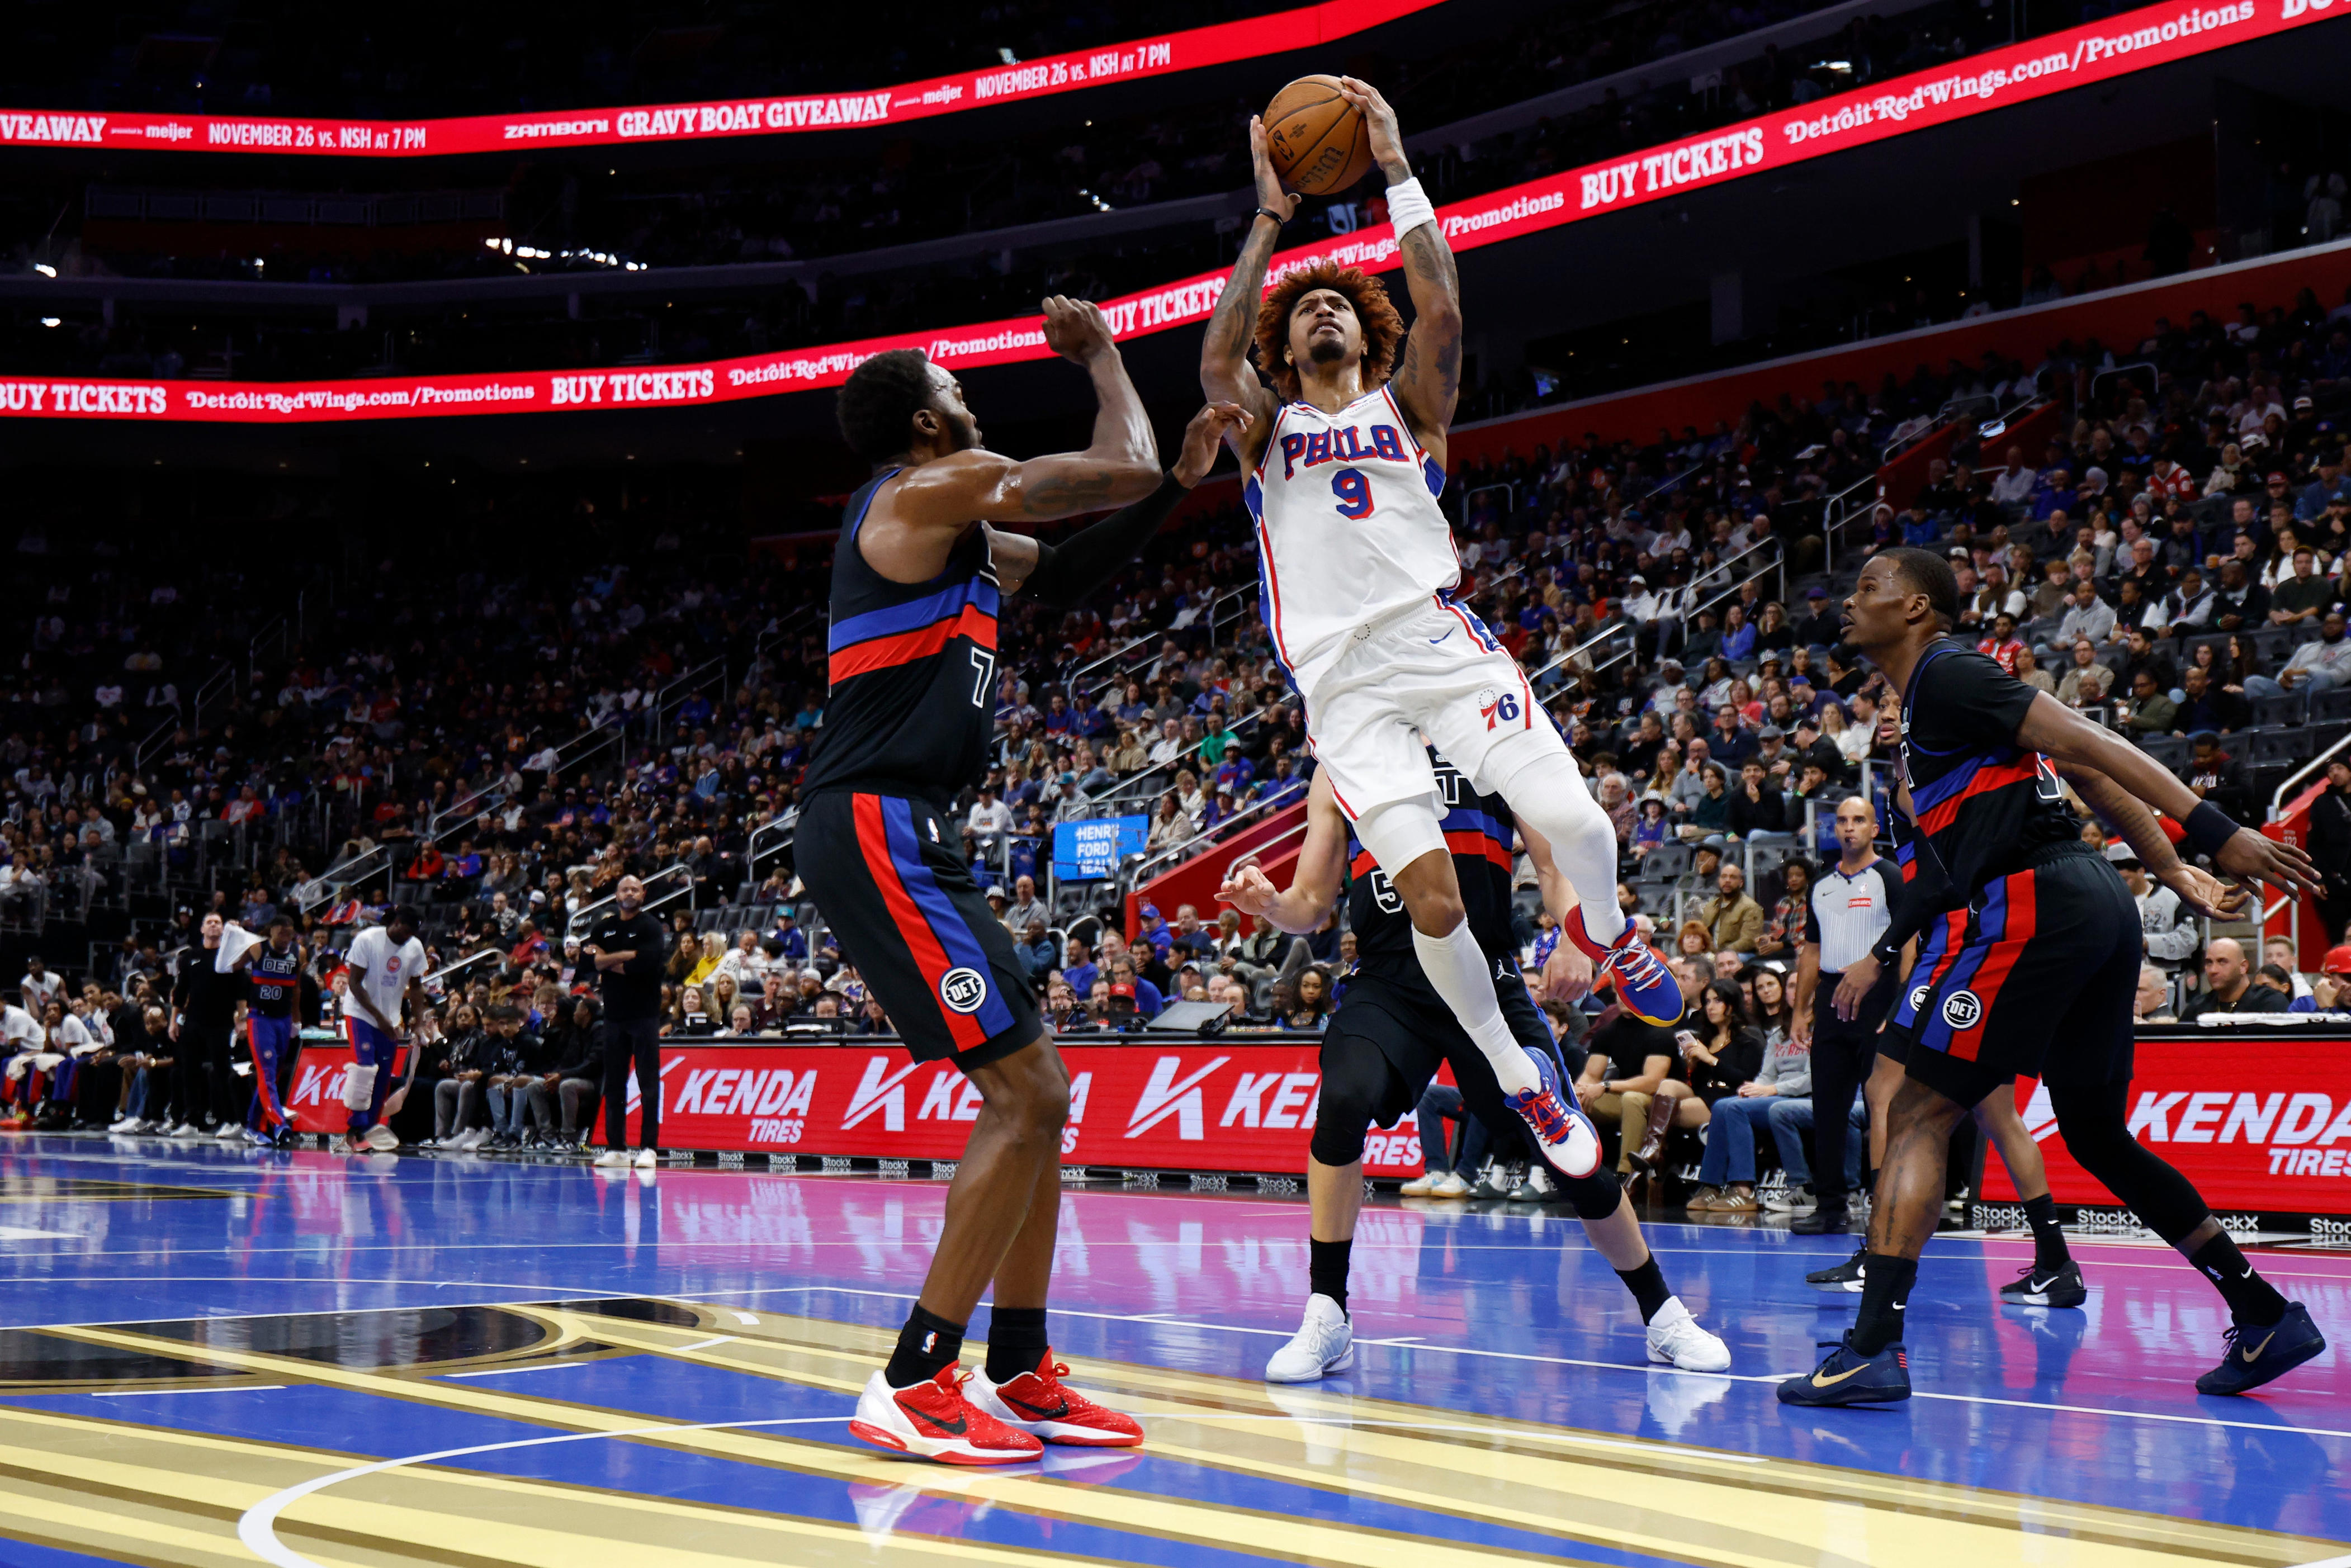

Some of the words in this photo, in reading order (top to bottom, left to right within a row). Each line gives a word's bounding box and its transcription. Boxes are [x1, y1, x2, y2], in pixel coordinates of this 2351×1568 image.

[975, 65, 1048, 100] NOVEMBER
[1051, 62, 1068, 86] 26
[1090, 52, 1119, 79] NSH
[1137, 47, 1147, 70] 7
[1148, 42, 1171, 68] PM
[923, 84, 963, 105] meijer
[0, 114, 107, 142] VEAWAY
[617, 107, 699, 138] GRAVY
[699, 103, 764, 133] BOAT
[765, 93, 892, 127] GIVEAWAY
[146, 122, 193, 142] meijer
[209, 122, 292, 147] NOVEMBER
[295, 125, 315, 148] 26
[340, 127, 372, 149] NSH
[392, 128, 401, 149] 7
[404, 127, 427, 149] PM
[1581, 162, 1639, 210] BUY
[1642, 127, 1765, 192] TICKETS
[1140, 277, 1227, 328] TICKETS
[52, 384, 167, 414] TICKETS
[551, 375, 606, 405] BUY
[609, 369, 715, 402] TICKETS
[1280, 424, 1410, 481] PHILA
[1331, 467, 1375, 520] 9
[971, 646, 995, 709] 7
[1480, 693, 1520, 732] 76
[1076, 841, 1110, 858] FORD
[263, 958, 296, 975] DET
[260, 985, 283, 1001] 20
[949, 977, 978, 1003] DET
[1948, 999, 1976, 1019] DET
[673, 1069, 818, 1117] KENDA
[748, 1119, 805, 1144] TIRES
[669, 1150, 695, 1160] StockX
[718, 1152, 744, 1163] StockX
[769, 1154, 797, 1165] StockX
[822, 1156, 852, 1168] StockX
[1362, 1135, 1422, 1166] RES
[878, 1159, 909, 1171] StockX
[933, 1162, 959, 1173] Stock
[1060, 1168, 1086, 1179] ockX
[1190, 1174, 1229, 1186] StockX
